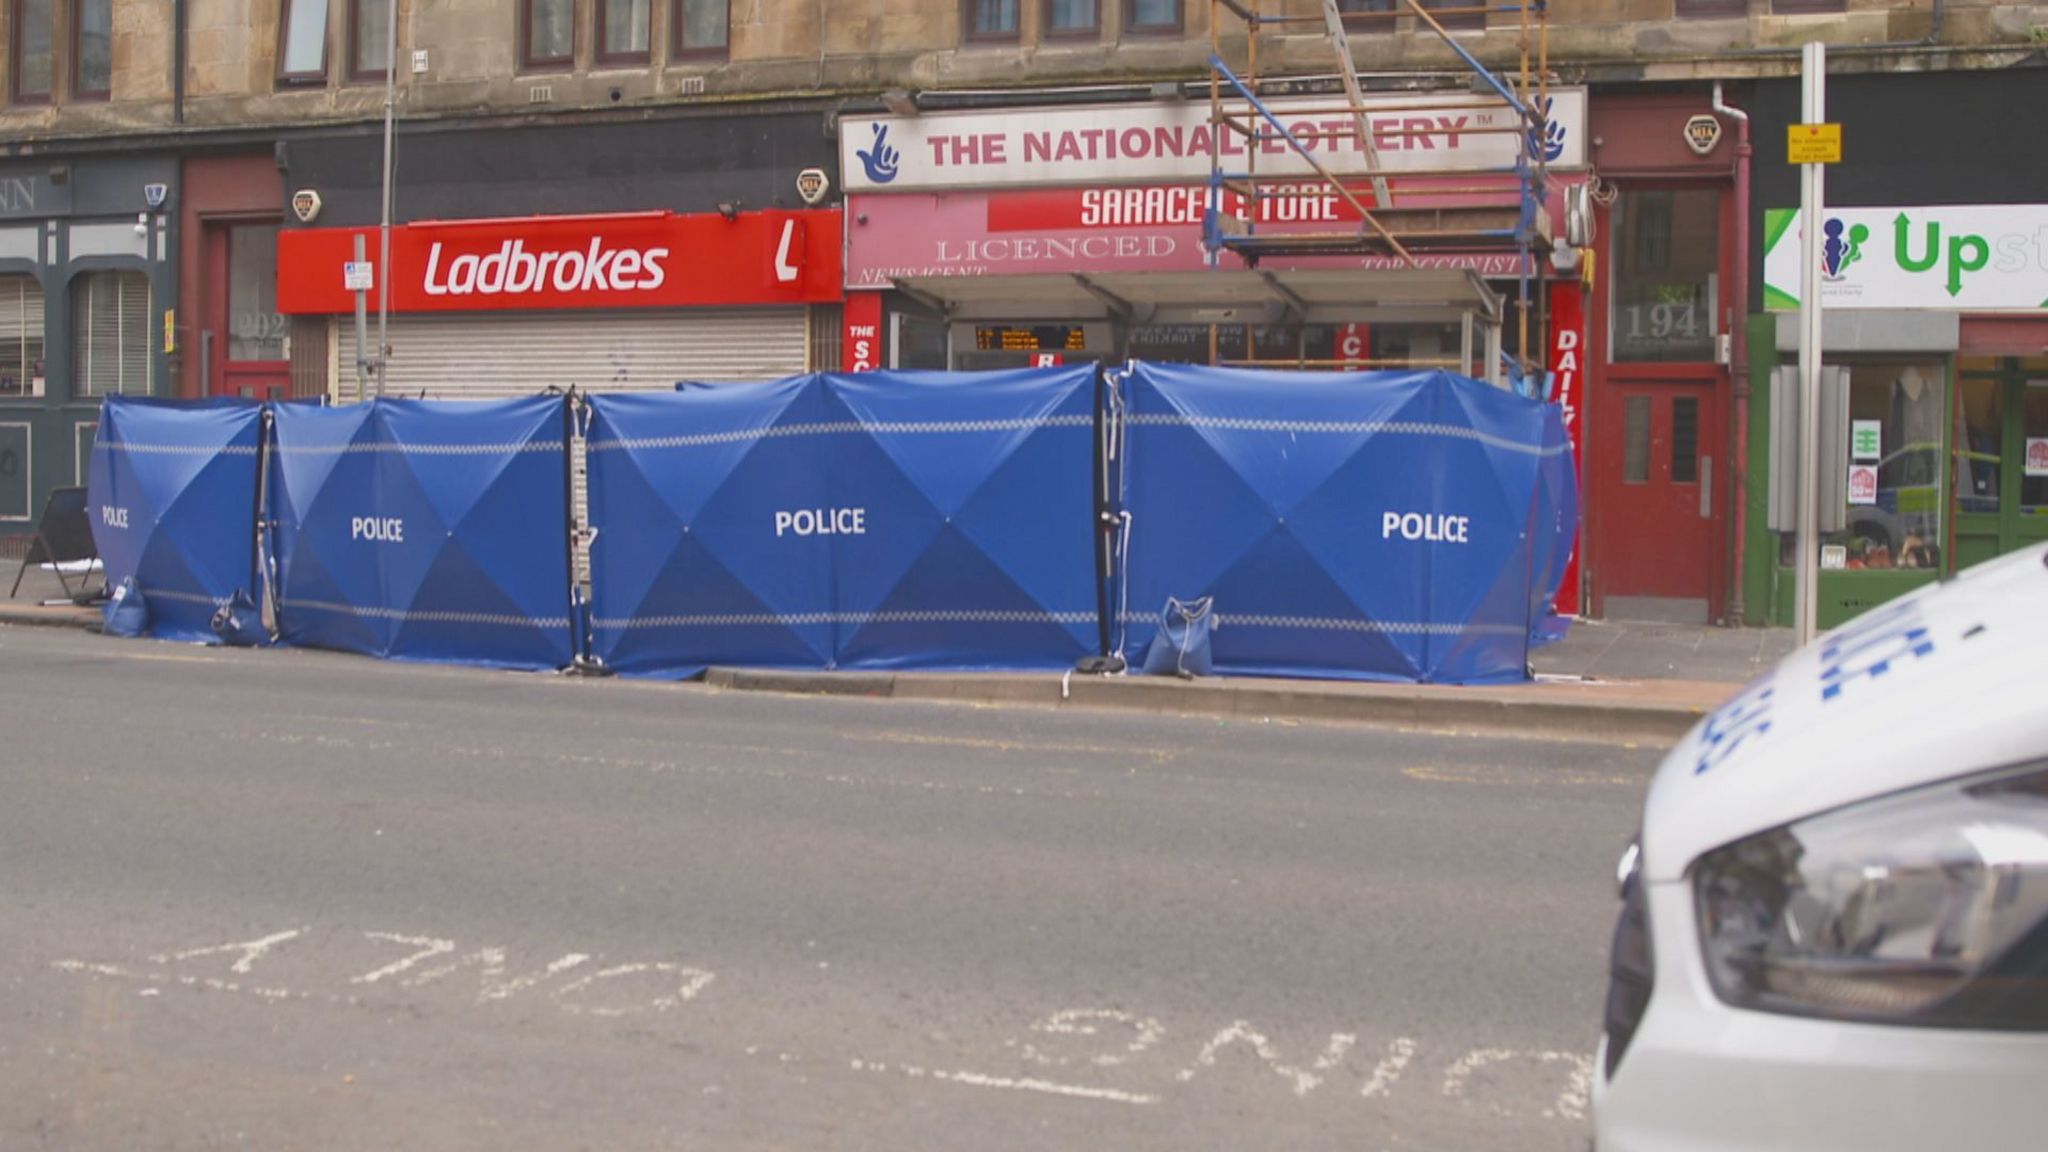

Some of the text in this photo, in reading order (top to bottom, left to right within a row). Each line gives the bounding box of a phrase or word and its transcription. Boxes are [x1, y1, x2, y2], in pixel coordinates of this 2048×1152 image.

[926, 132, 1007, 166] THE
[1023, 125, 1244, 162] NATIONAL
[1261, 115, 1469, 155] LOTTERY
[936, 235, 1176, 262] LICENCED
[423, 236, 669, 295] Ladbrokes
[849, 325, 875, 338] THE
[1625, 304, 1699, 338] 194
[102, 504, 129, 529] POLICE
[352, 517, 403, 542] POLICE
[775, 507, 866, 537] POLICE
[1382, 511, 1469, 543] POLICE
